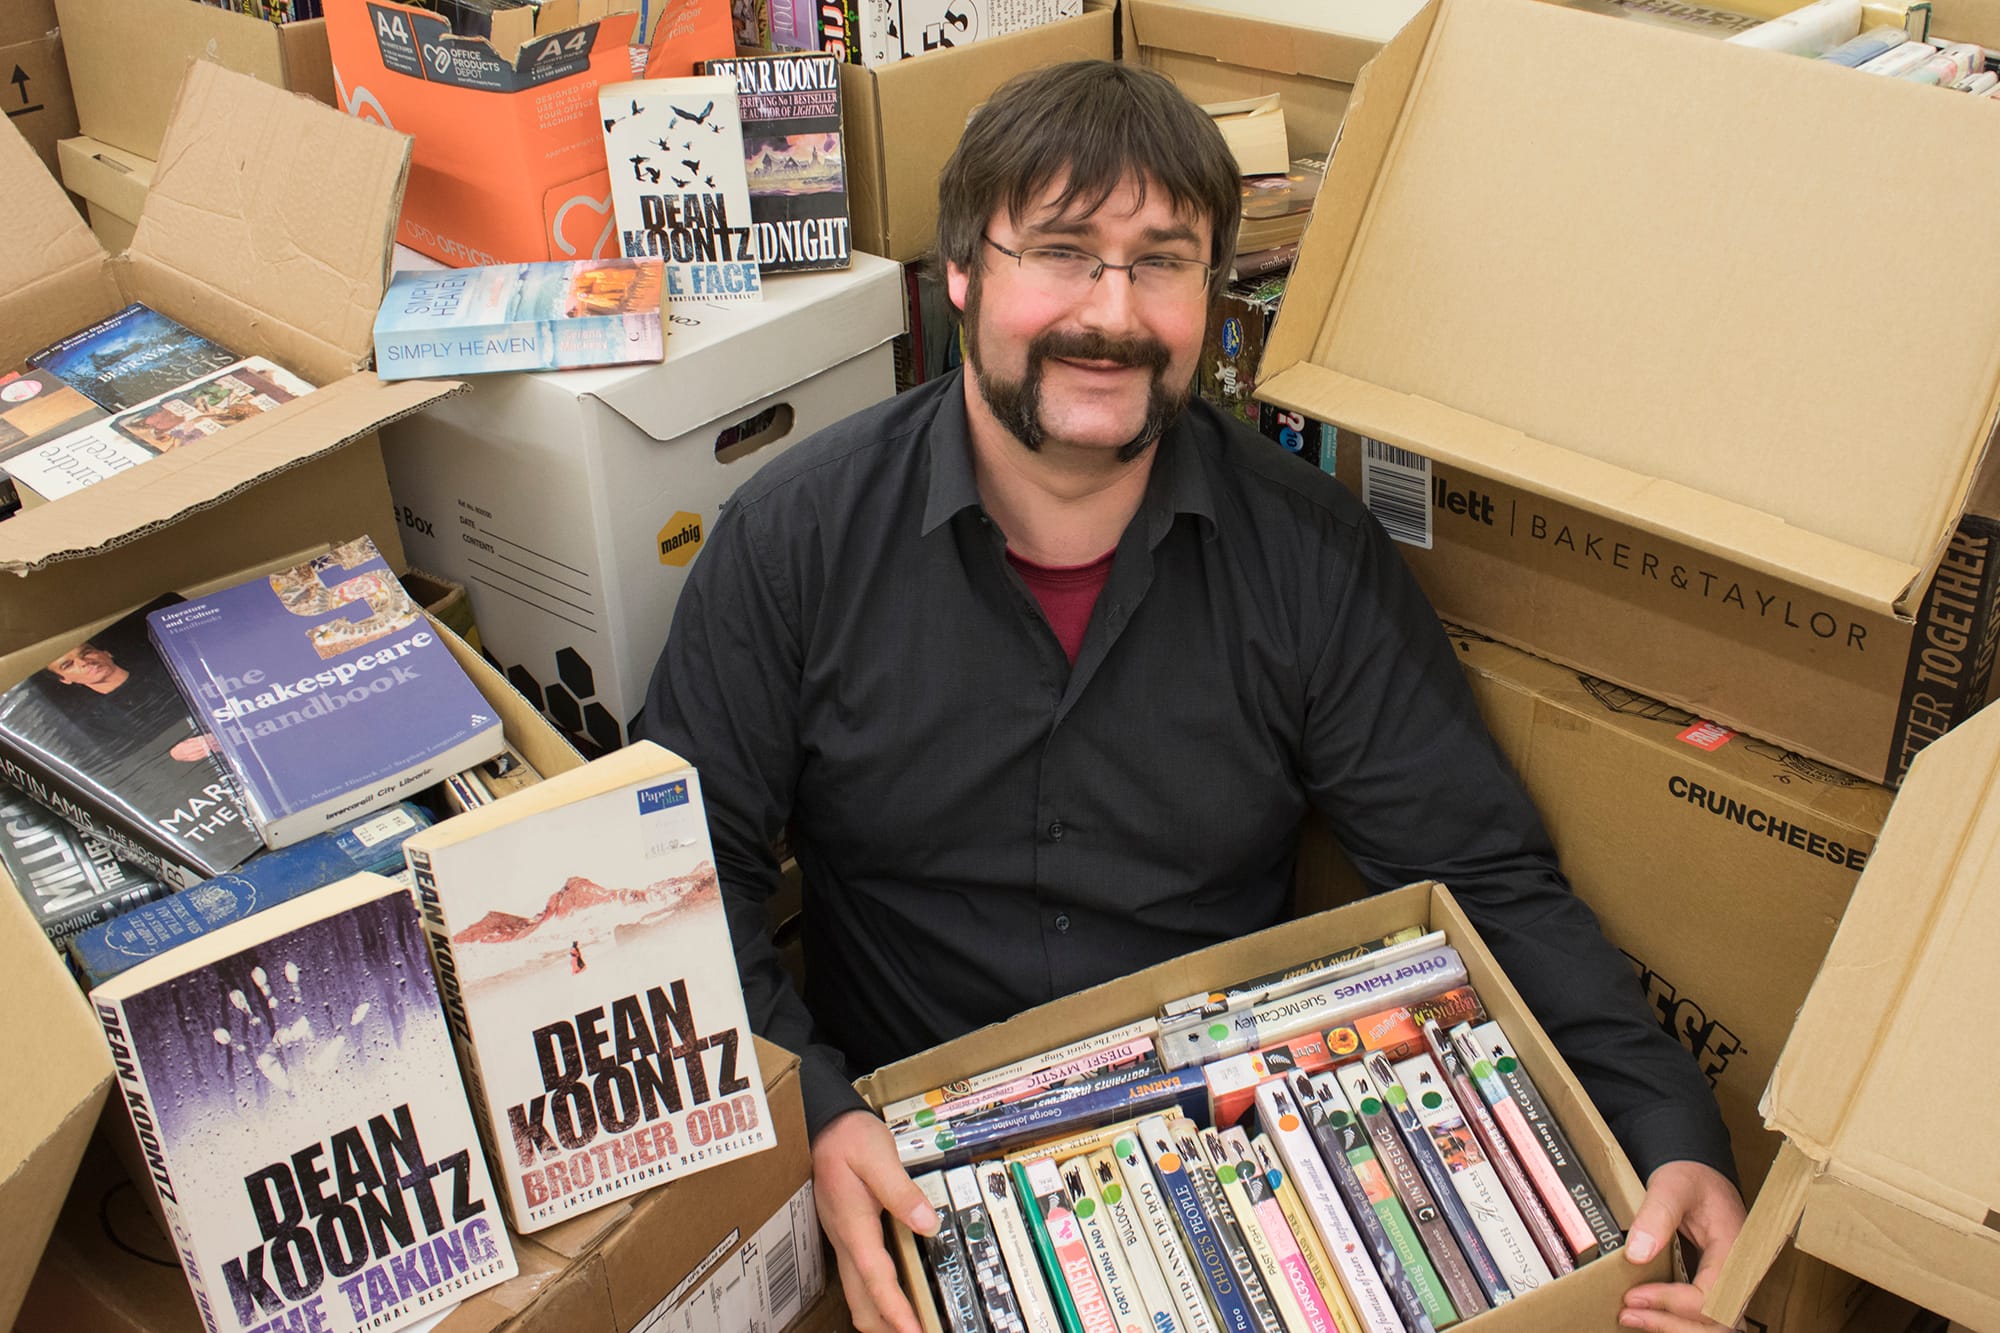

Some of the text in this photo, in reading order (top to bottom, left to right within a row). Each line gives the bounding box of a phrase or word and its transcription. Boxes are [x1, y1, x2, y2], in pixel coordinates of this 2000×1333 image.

[377, 11, 409, 45] A4
[450, 48, 481, 60] OFFICE
[537, 31, 587, 62] A4
[453, 58, 500, 72] PRODUCTS
[455, 67, 482, 79] DEPOT
[759, 61, 772, 93] R
[775, 57, 837, 91] KOONTZ
[536, 80, 597, 104] DESIGNED FOR
[537, 103, 553, 113] USE
[566, 95, 581, 103] ALL
[794, 92, 837, 105] BESTSELLER
[539, 99, 593, 121] YOUR OFFICE
[540, 111, 583, 129] MACHINES
[748, 104, 835, 119] AUTHOR OF LIGHTNING
[640, 193, 727, 229] DEAN
[623, 227, 755, 263] KOONTZ
[432, 273, 468, 318] HEAVEN
[691, 263, 759, 295] FACE
[405, 278, 440, 315] SIMPLY
[99, 342, 179, 384] BETRAYAL
[388, 337, 535, 361] SIMPLY HEAVEN
[403, 506, 435, 538] Box
[459, 515, 476, 530] DATE
[660, 522, 701, 555] marbig
[462, 533, 495, 554] CONTENTS
[160, 602, 206, 623] Literature
[164, 606, 220, 629] and Culture
[1917, 530, 1989, 689] TOGETHER
[199, 668, 266, 700] the
[212, 631, 433, 724] shakespeare
[221, 664, 422, 746] handbook
[377, 784, 398, 799] City
[641, 787, 673, 804] Paper
[662, 794, 684, 808] plus
[50, 793, 96, 830] AMIS
[184, 806, 238, 844] THE
[1669, 774, 1868, 873] CRUNCHEESE
[104, 825, 127, 846] THE
[166, 863, 185, 890] B
[47, 911, 99, 939] DOMINIC
[412, 848, 473, 1045] DEAN KOONTZ
[1231, 954, 1448, 1033] Other Halves Sue McCauley
[531, 978, 697, 1093] DEAN
[1365, 1008, 1413, 1042] PLANET
[1039, 1050, 1065, 1065] Sings
[1065, 1042, 1092, 1057] Spirit
[1025, 1046, 1133, 1088] DIESEL MYSTIC
[1093, 1067, 1152, 1093] FOOTPRINTS
[506, 1028, 749, 1168] KOONTZ
[991, 1073, 1182, 1135] BARNEY George Johnston
[99, 1005, 201, 1284] DEAN KOONTZ THE
[521, 1094, 759, 1209] BROTHER ODD
[1505, 1069, 1625, 1253] spinners Anthony McCarten
[243, 1103, 429, 1242] DEAN
[530, 1131, 763, 1221] THE INTERNATIONAL BESTSELLER
[1372, 1123, 1438, 1226] QUINTESSENCE
[1138, 1180, 1163, 1214] ROO
[1191, 1168, 1220, 1220] RUTH
[1359, 1200, 1374, 1217] Joy
[1457, 1168, 1506, 1231] HAREM
[221, 1149, 486, 1327] KOONTZ
[1109, 1201, 1140, 1246] BULLOCK
[1150, 1213, 1171, 1237] DE
[1247, 1224, 1263, 1246] LIGHT
[1322, 1199, 1354, 1244] stephanie
[1366, 1215, 1380, 1232] The
[1089, 1227, 1107, 1252] AND
[1287, 1213, 1328, 1289] SOUTH ISLAND NURSE
[338, 1217, 499, 1323] TAKING
[1097, 1250, 1120, 1284] YARNS
[1175, 1184, 1247, 1330] Roo CHLOE'S PEOPLE
[1260, 1250, 1277, 1276] PAST
[1349, 1255, 1366, 1278] tears
[1374, 1205, 1444, 1315] making lemonade
[1488, 1225, 1541, 1296] ENGLISH
[418, 1260, 506, 1306] BESTSELLER
[687, 1270, 700, 1284] UPS
[935, 1251, 973, 1303] work
[1231, 1246, 1268, 1303] RACE
[1284, 1260, 1320, 1319] LANGDON
[1110, 1284, 1132, 1316] FORTY
[1361, 1284, 1395, 1330] fountain
